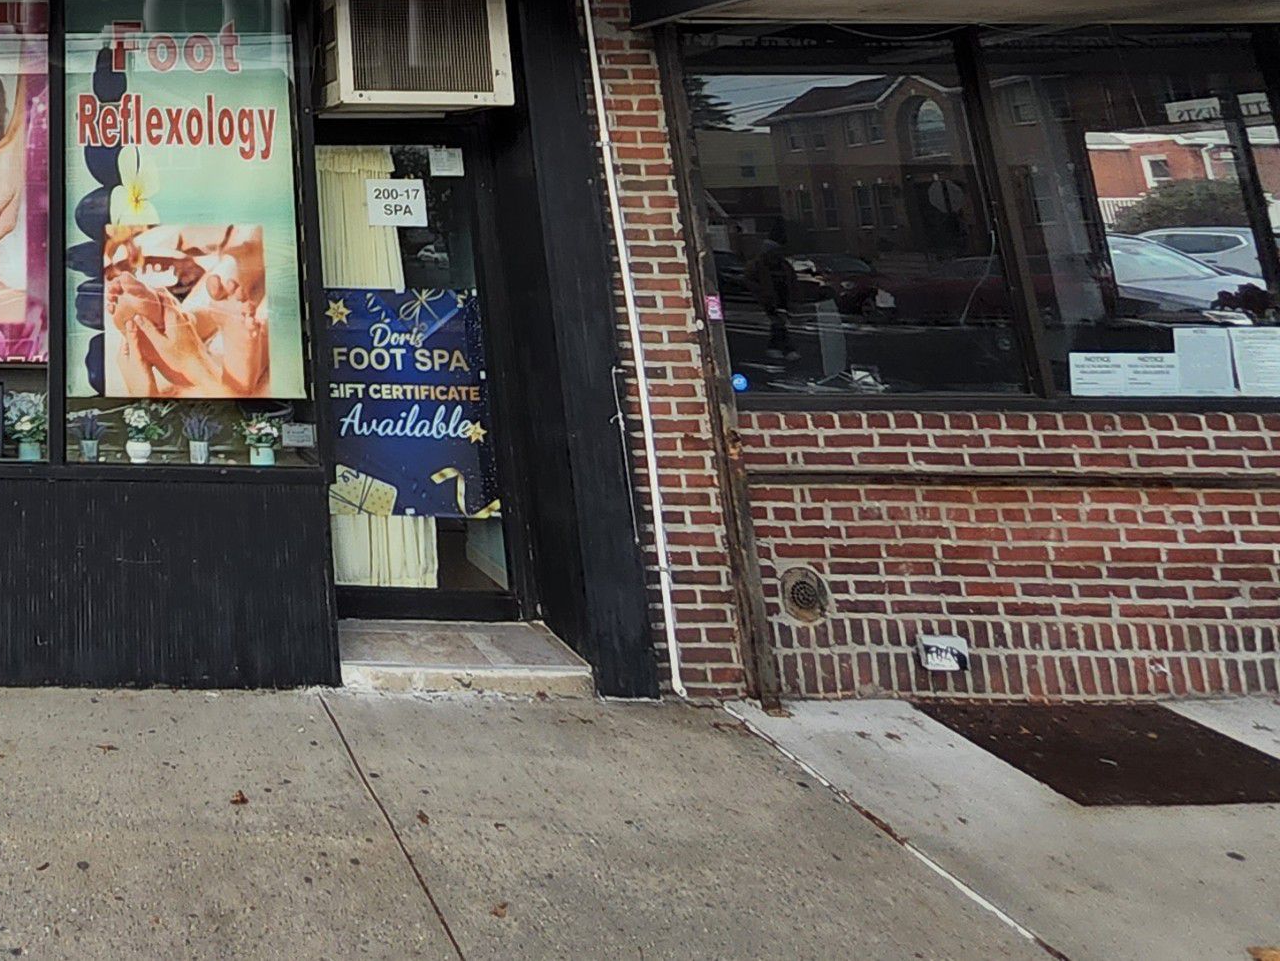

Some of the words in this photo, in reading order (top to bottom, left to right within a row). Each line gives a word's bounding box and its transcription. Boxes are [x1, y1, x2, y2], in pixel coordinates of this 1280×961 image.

[112, 20, 241, 73] Foot
[77, 93, 276, 161] Reflexology
[373, 187, 420, 201] 200-17
[383, 203, 413, 216] SPA
[369, 320, 425, 349] Doris
[332, 347, 407, 371] FOOT
[414, 348, 470, 372] SPA
[368, 384, 481, 401] CERTIFICATE
[339, 402, 472, 439] Available
